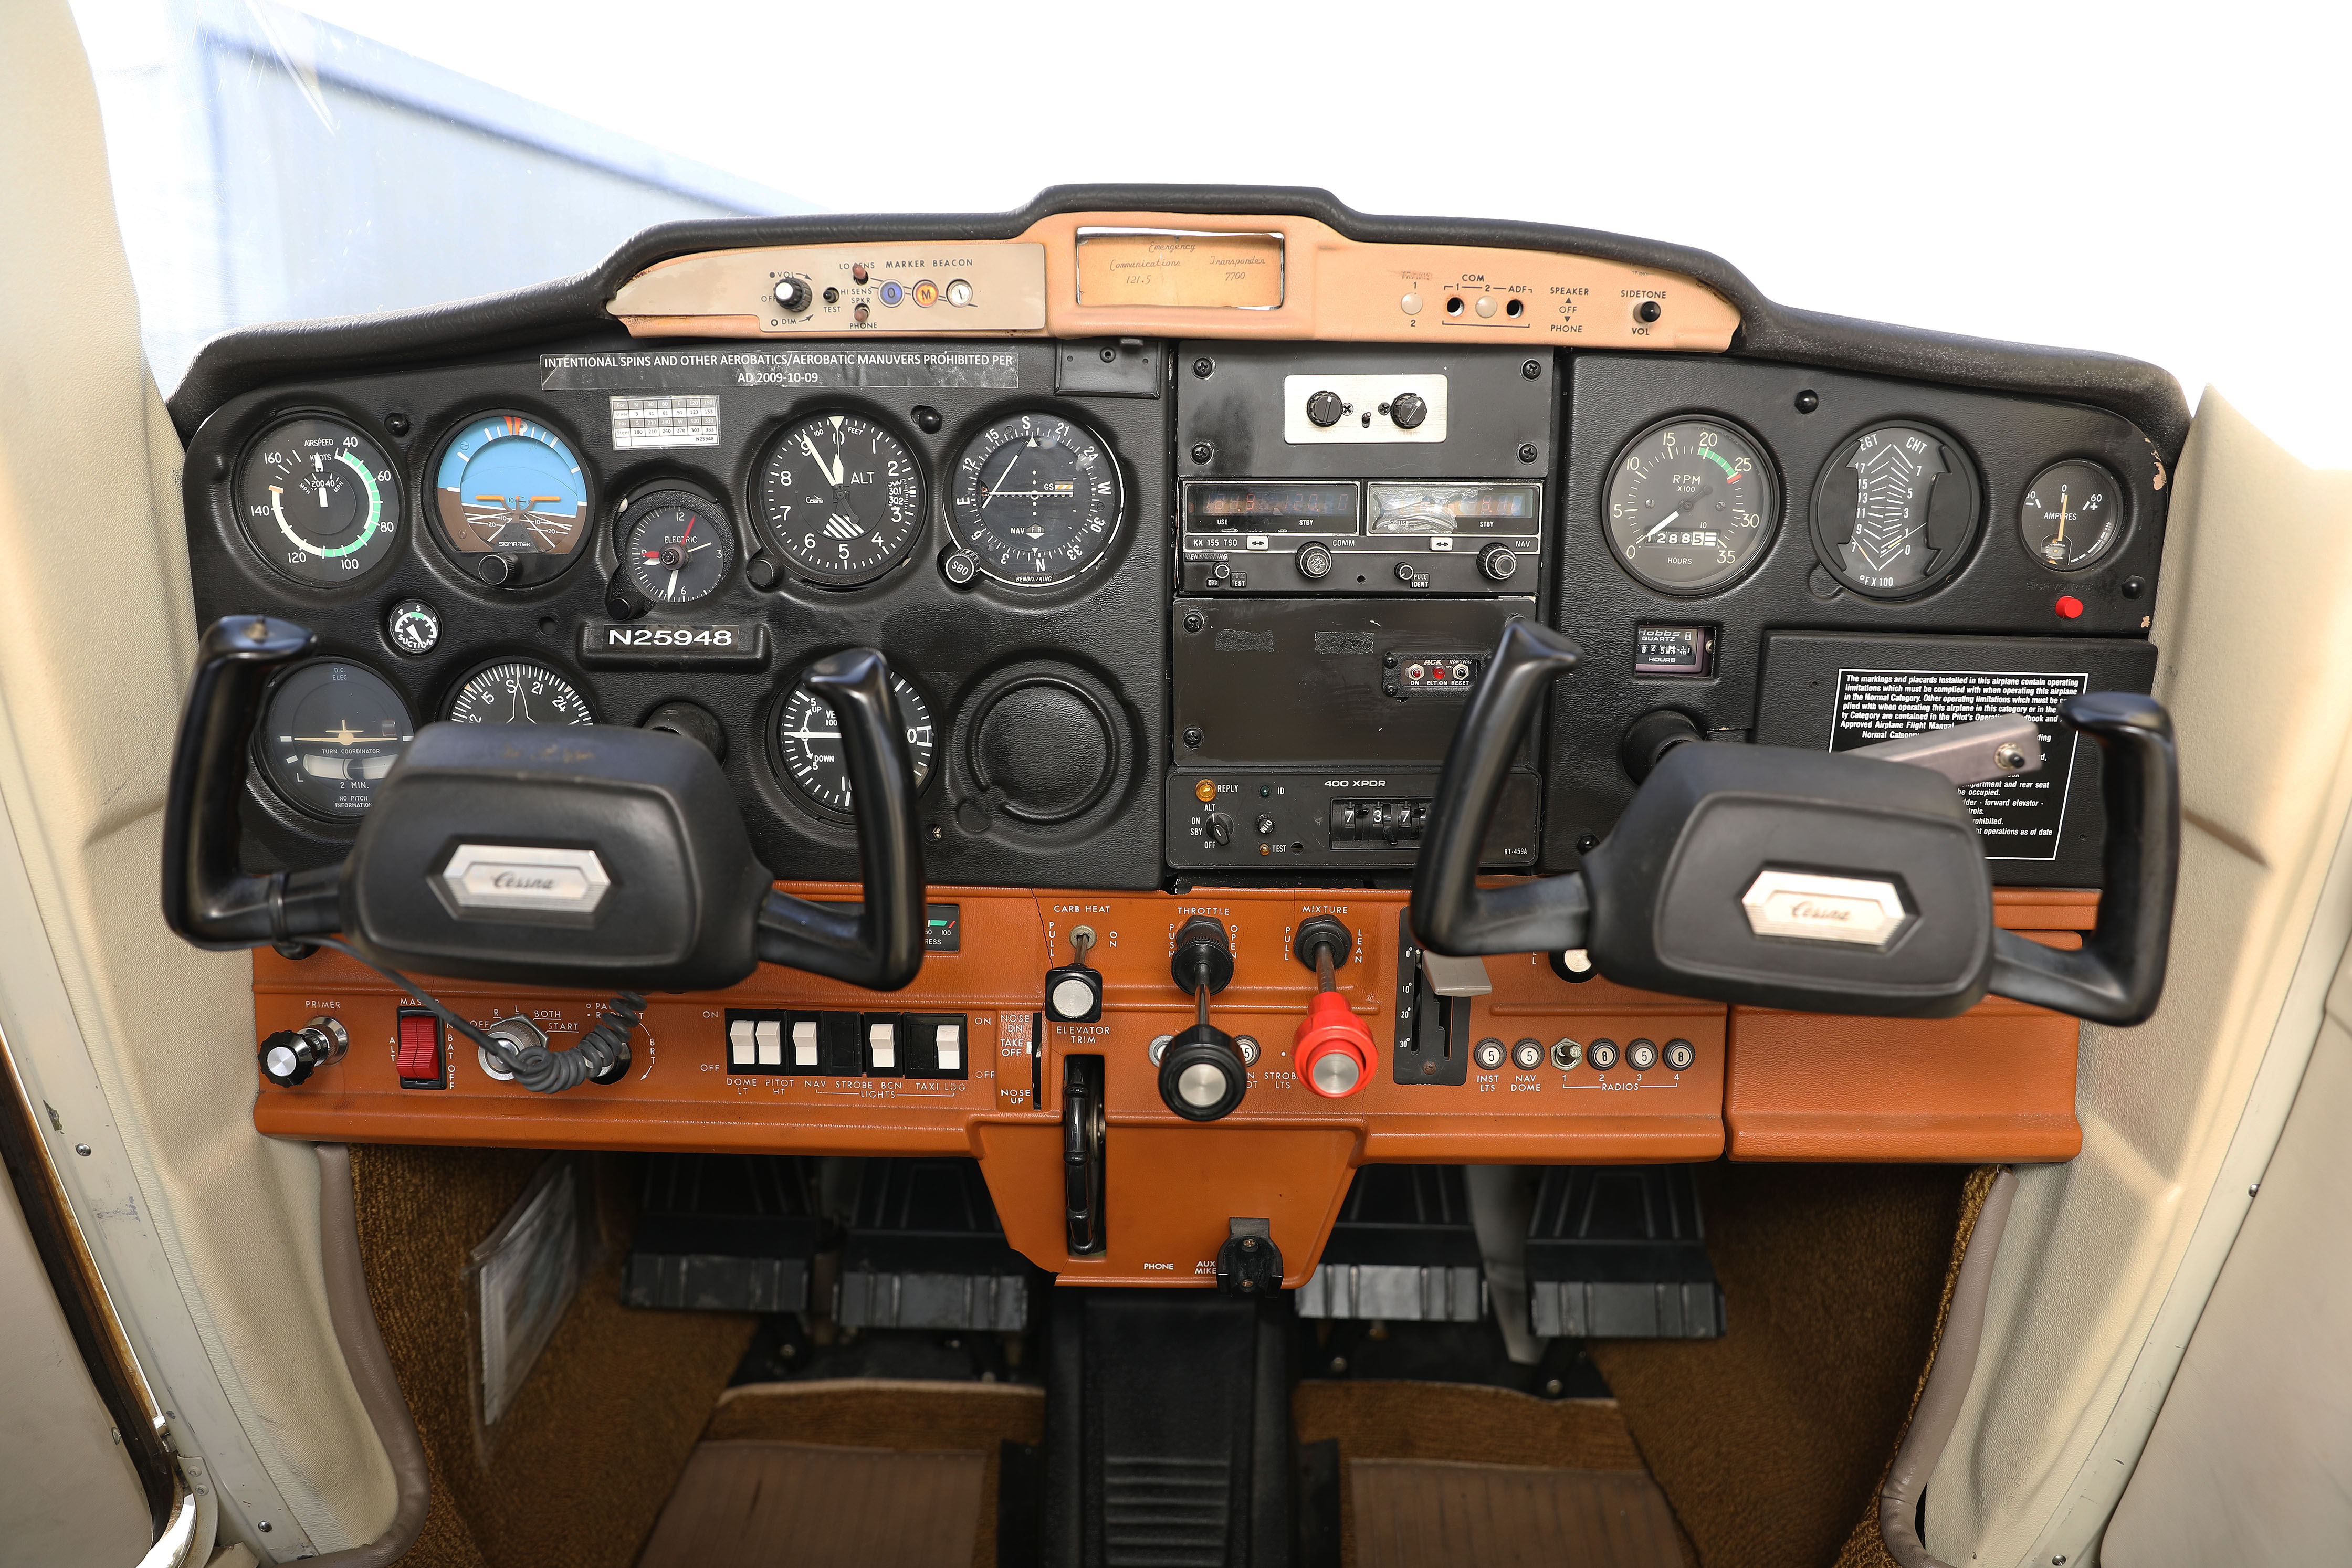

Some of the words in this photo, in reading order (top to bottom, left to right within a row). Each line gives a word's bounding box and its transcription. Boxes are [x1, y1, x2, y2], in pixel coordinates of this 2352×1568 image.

[1149, 241, 1195, 252] Emergency
[1110, 259, 1181, 271] Communications
[1210, 256, 1265, 266] Transponder
[1126, 275, 1151, 283] 121.5
[1225, 272, 1245, 281] 7700
[1621, 290, 1666, 299] SIDETONE
[545, 357, 618, 367] INTENTIONAL
[621, 356, 651, 366] SPINS
[654, 356, 678, 366] AND
[680, 356, 717, 366] OTHER
[720, 353, 855, 366] AEROBATICS/AEROBATIC
[858, 354, 921, 365] MANUVERS
[924, 354, 989, 365] PROHIBITED
[992, 355, 1012, 365] PER
[738, 373, 752, 382] AD
[756, 372, 818, 383] 2009-10-09
[848, 427, 863, 435] FEET
[343, 436, 358, 447] 40
[1699, 432, 1717, 447] 20
[1906, 437, 1927, 454] CHT
[264, 452, 281, 464] 160
[377, 471, 391, 481] 60
[851, 472, 874, 484] ALT
[1673, 474, 1701, 485] RPM
[806, 495, 824, 503] Cessna
[251, 506, 270, 516] 140
[380, 522, 394, 532] 80
[288, 553, 306, 563] 120
[341, 559, 359, 569] 100
[398, 634, 433, 648] SUCTION
[608, 630, 732, 646] N25948
[1861, 675, 1892, 684] markings
[2047, 679, 2079, 687] operating
[1968, 788, 2000, 797] occupied.
[1178, 907, 1230, 915] THROTTLE
[1303, 906, 1348, 914] MIXTURE
[306, 1001, 341, 1009] PRIMER
[1001, 1015, 1030, 1023] NOSE
[1057, 1026, 1110, 1035] ELEVATOR
[1001, 1039, 1023, 1047] TAKE
[1001, 1048, 1021, 1057] OFF
[836, 1081, 873, 1089] STROBE
[1602, 1082, 1639, 1091] RADIOS
[861, 1090, 896, 1099] LIGHTS
